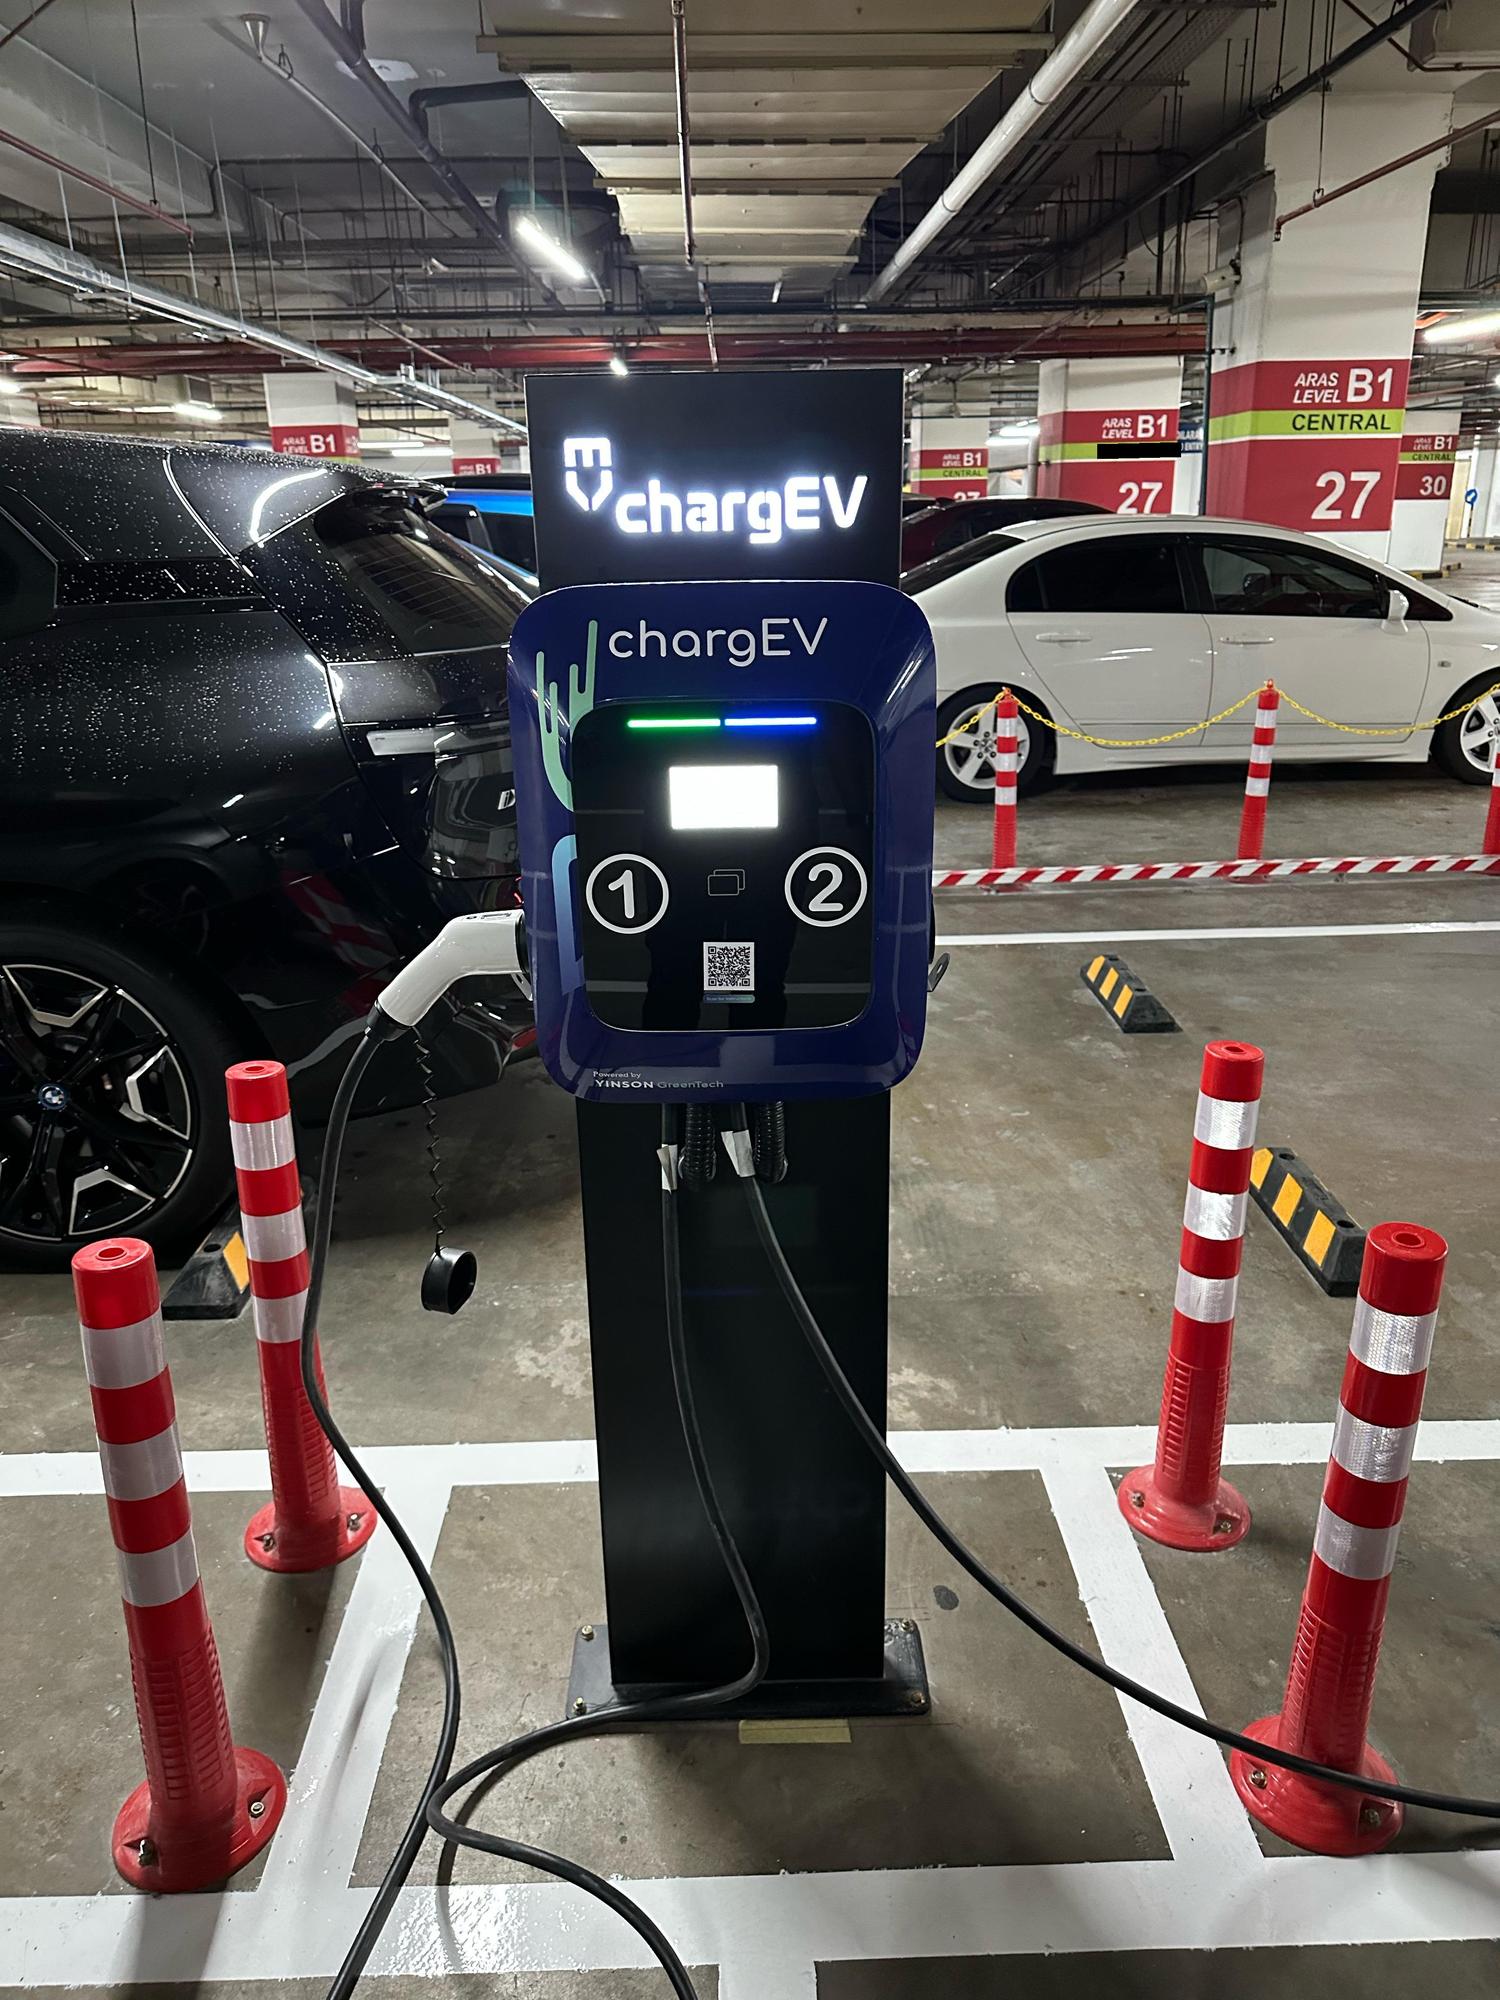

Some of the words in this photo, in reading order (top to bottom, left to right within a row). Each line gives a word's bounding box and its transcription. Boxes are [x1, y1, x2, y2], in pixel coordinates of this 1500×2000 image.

[1294, 373, 1339, 386] ARAS
[1347, 367, 1393, 402] B1
[1293, 389, 1341, 403] LEVEL
[1102, 418, 1132, 428] ARAS
[1137, 414, 1168, 438] B1
[1292, 414, 1391, 431] CENTRAL
[282, 437, 306, 445] ARAS
[1102, 429, 1134, 439] LEVEL
[283, 446, 310, 454] LEVEL
[310, 433, 336, 453] B1
[1434, 436, 1453, 450] B1
[963, 452, 982, 466] B1
[1412, 453, 1451, 461] CENTRAL
[475, 464, 491, 475] B1
[1420, 475, 1447, 496] 30
[1116, 482, 1163, 515] 27
[1311, 471, 1381, 519] 27
[615, 475, 868, 544] chargEV
[608, 617, 828, 667] chargEV
[608, 869, 635, 919] 1
[808, 862, 843, 911] 2
[595, 1079, 654, 1089] YINSON
[657, 1080, 724, 1089] GreenTech
